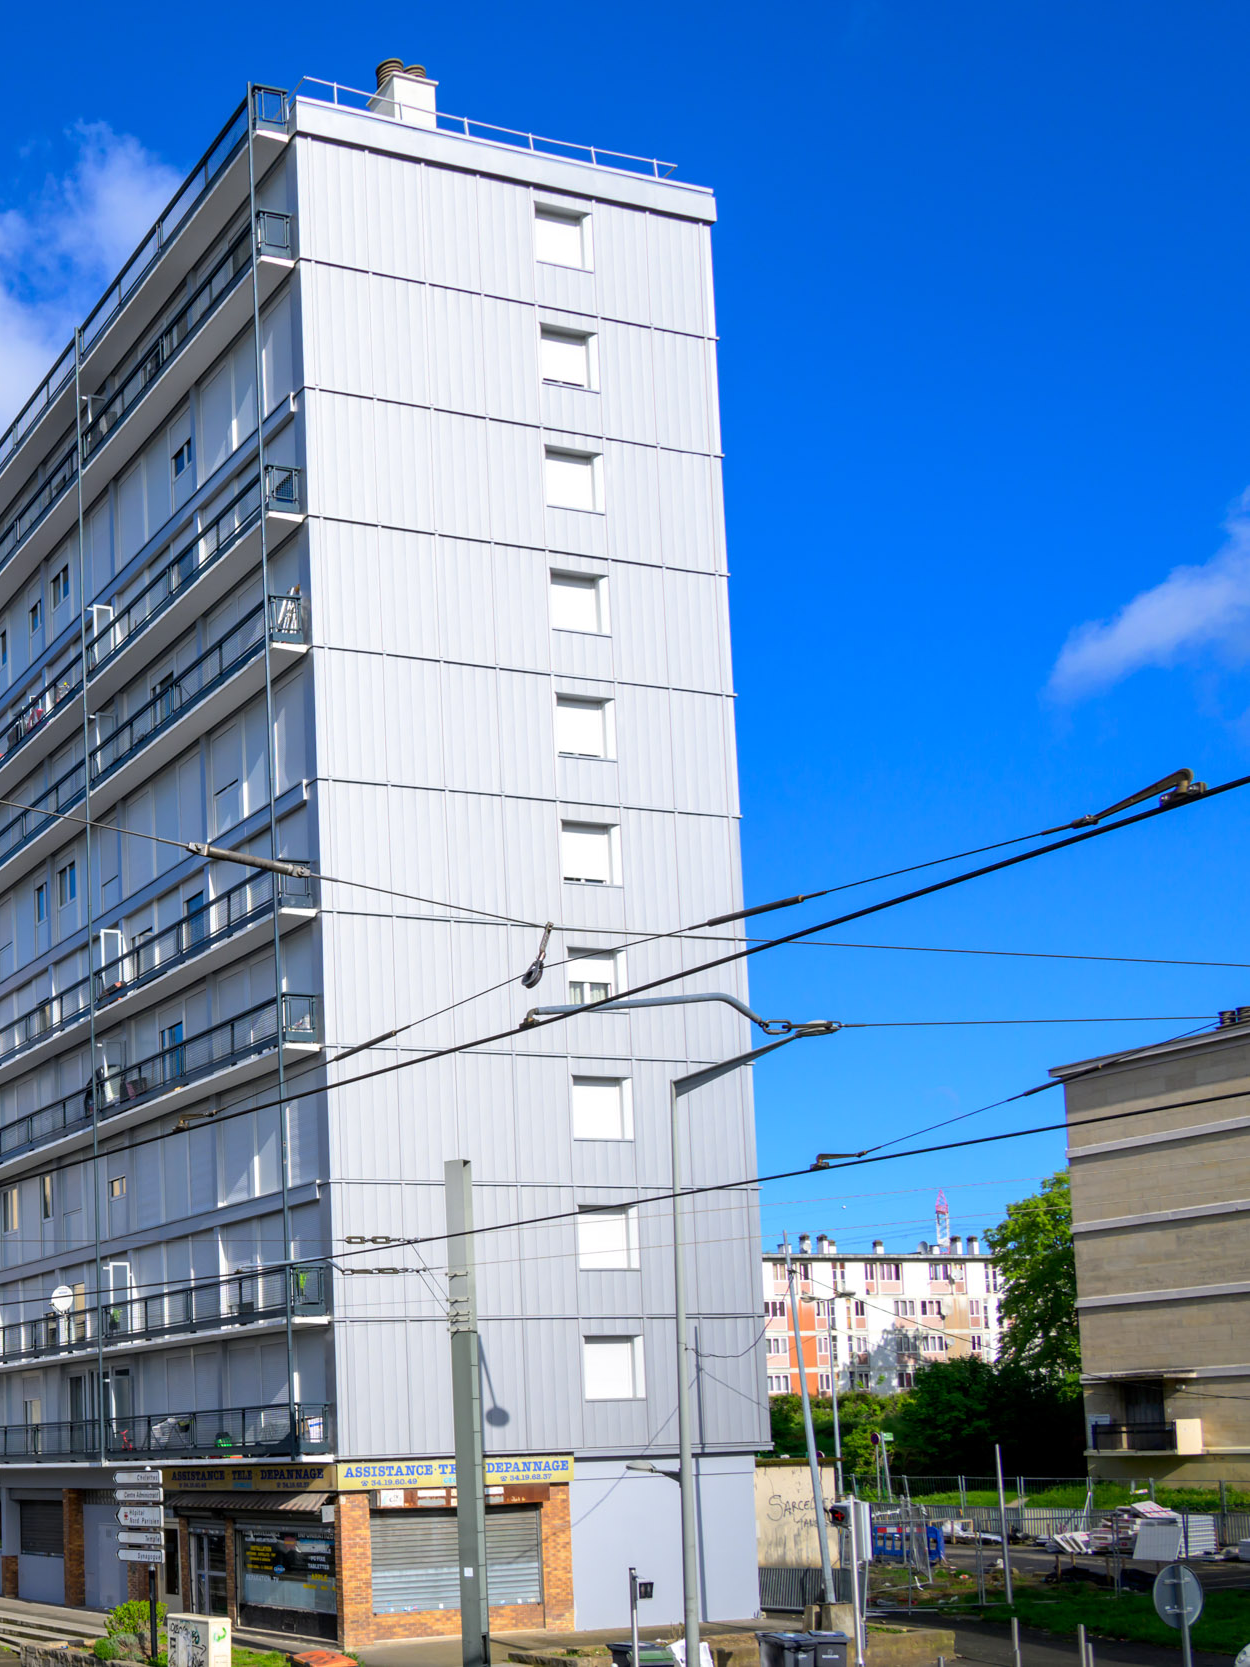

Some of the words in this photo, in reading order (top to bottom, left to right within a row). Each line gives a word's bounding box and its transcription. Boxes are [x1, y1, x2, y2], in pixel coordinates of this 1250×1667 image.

[343, 1464, 433, 1478] ASSISTANCE
[486, 1460, 569, 1474] DEPANNAGE
[171, 1470, 225, 1481] ASSISTANCE
[232, 1470, 253, 1480] TELE
[260, 1468, 324, 1480] DEPANNAGE
[129, 1517, 140, 1525] Nord
[145, 1535, 160, 1543] Temple
[137, 1552, 161, 1562] Synagogue
